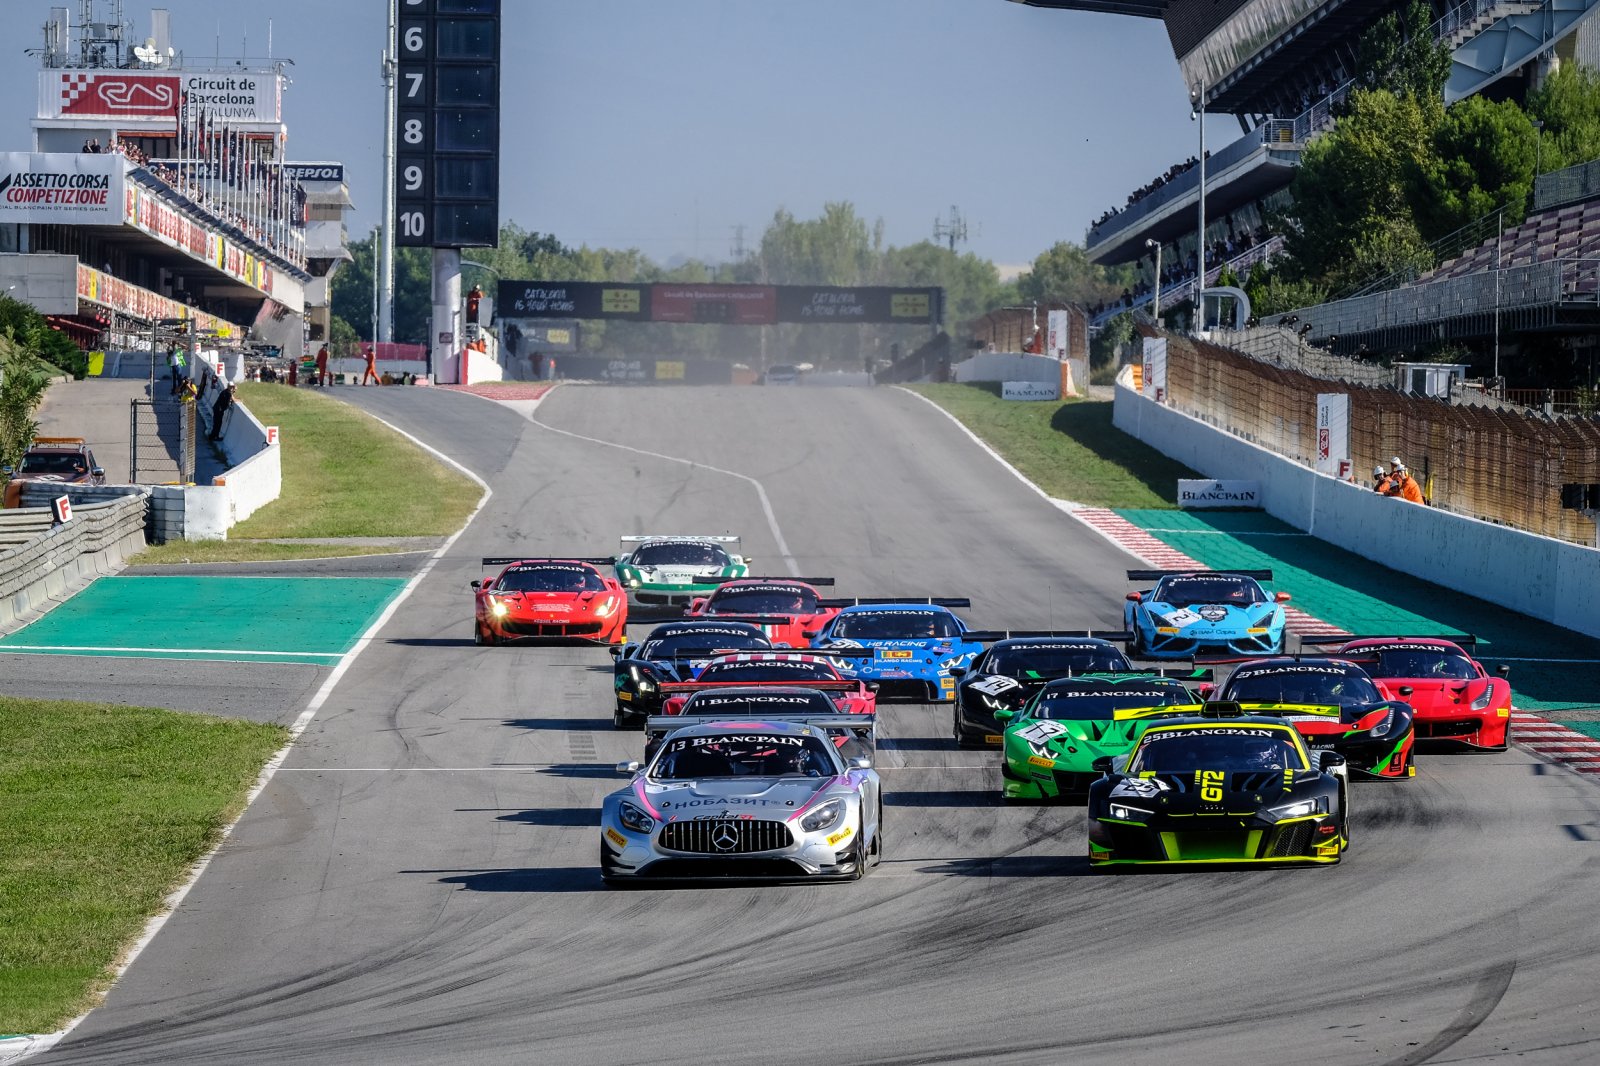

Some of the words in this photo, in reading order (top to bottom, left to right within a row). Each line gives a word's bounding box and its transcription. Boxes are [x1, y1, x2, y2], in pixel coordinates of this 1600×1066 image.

[404, 27, 424, 52] 6
[188, 77, 236, 91] Circuit
[239, 78, 256, 91] de
[405, 73, 424, 98] 7
[189, 92, 255, 105] Barcelona
[403, 119, 424, 144] 8
[12, 173, 68, 188] ASSETTO
[68, 174, 109, 189] CORSA
[404, 165, 423, 190] 9
[6, 187, 108, 204] COMPETIZIONE
[400, 212, 425, 237] 10
[216, 363, 224, 375] F
[1155, 388, 1164, 401] F
[267, 428, 278, 443] F
[1339, 461, 1351, 477] F
[1182, 490, 1256, 501] BLANCPAIN
[59, 498, 70, 520] F
[519, 565, 586, 573] BLANCPAIN
[665, 628, 749, 637] BLANCPAIN
[1359, 644, 1446, 654] BLANCPAIN
[722, 661, 815, 671] BLANCPAIN
[1253, 666, 1347, 676] BLANCPAIN
[708, 696, 810, 704] BLANCPAIN
[670, 740, 686, 753] 13
[691, 735, 805, 748] BLANCPAIN
[1143, 734, 1161, 745] 25
[1160, 728, 1274, 741] BLANCPAIN
[1200, 769, 1226, 803] GT2
[674, 797, 770, 810] НОБАЗИТ
